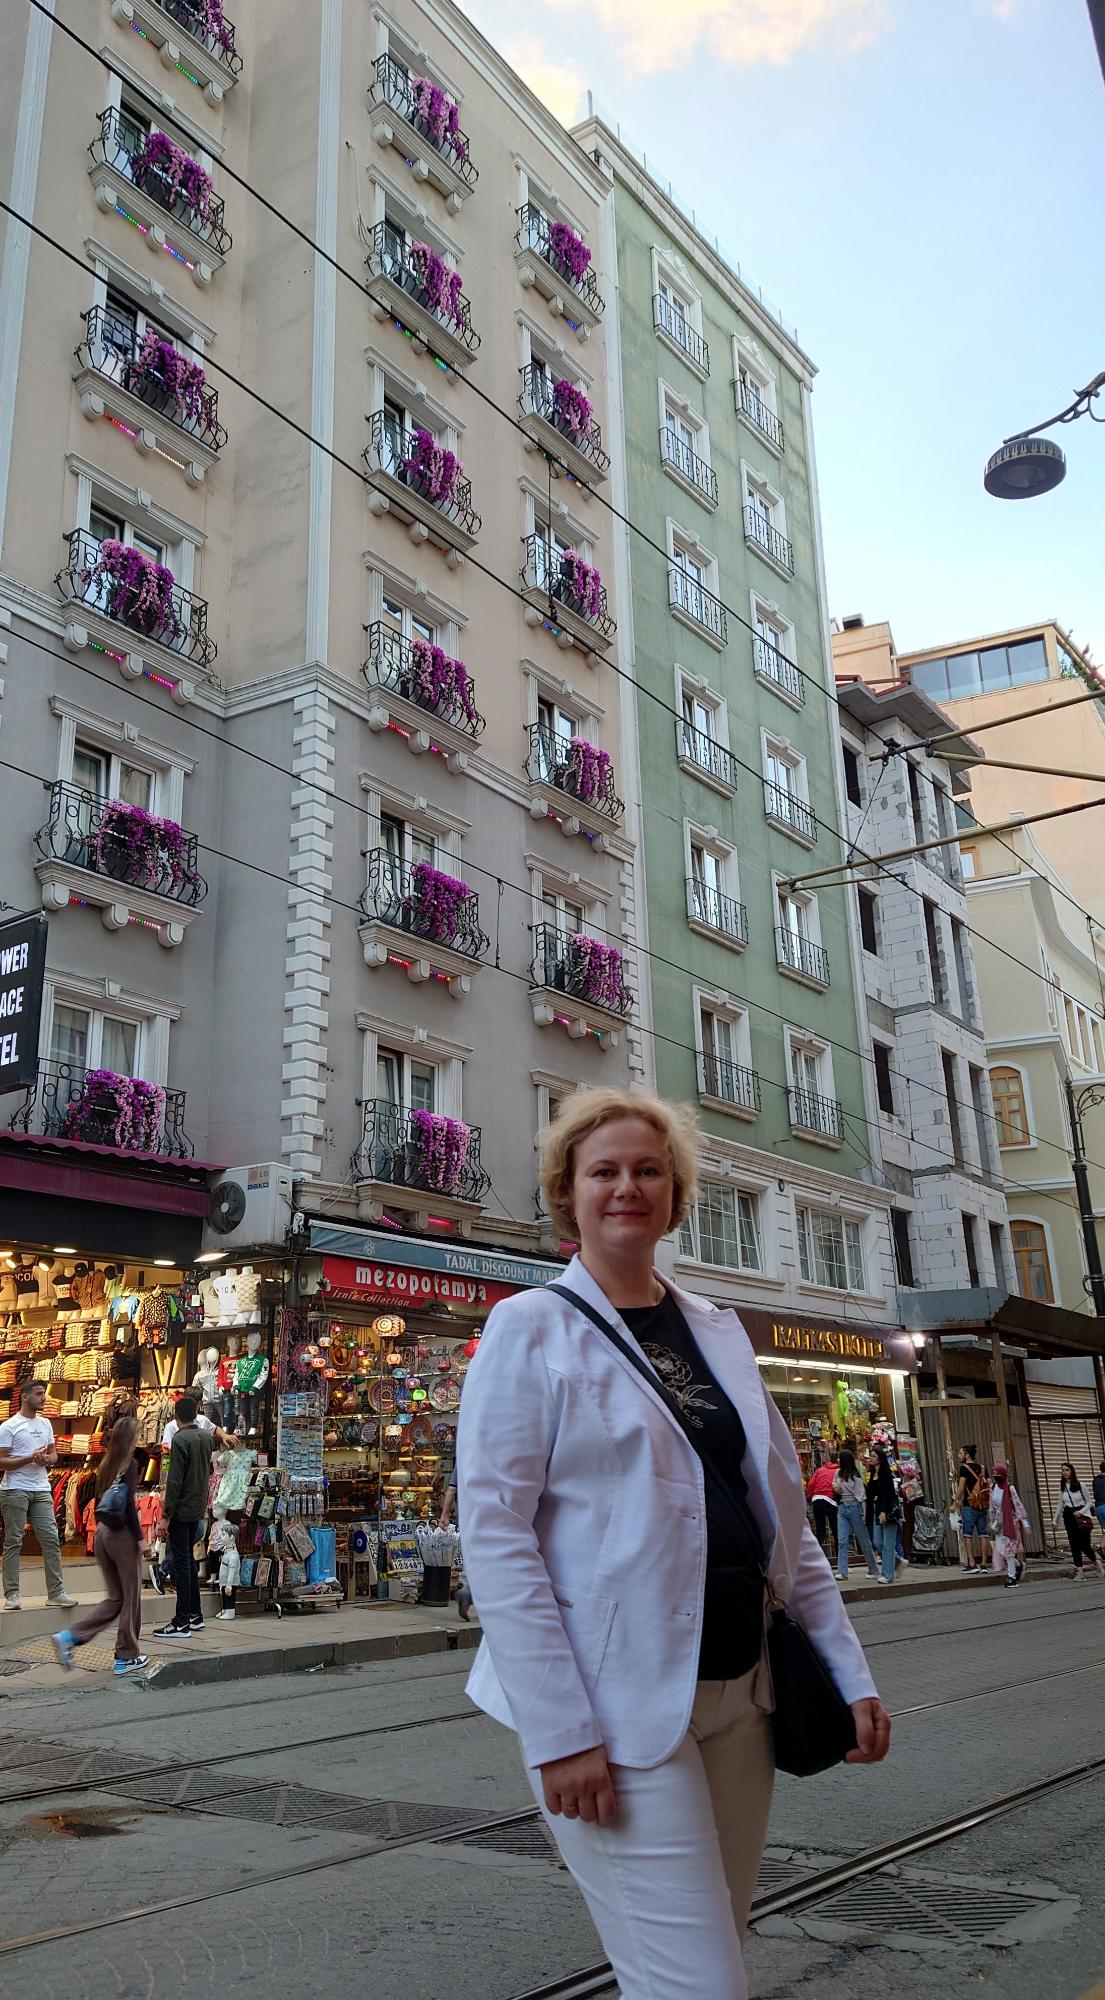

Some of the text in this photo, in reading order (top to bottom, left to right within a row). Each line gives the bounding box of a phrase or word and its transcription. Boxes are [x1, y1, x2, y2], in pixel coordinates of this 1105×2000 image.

[0, 943, 28, 976] WER
[445, 1254, 479, 1272] TADAL
[355, 1267, 487, 1302] mezopotamya
[361, 1293, 410, 1307] Collection
